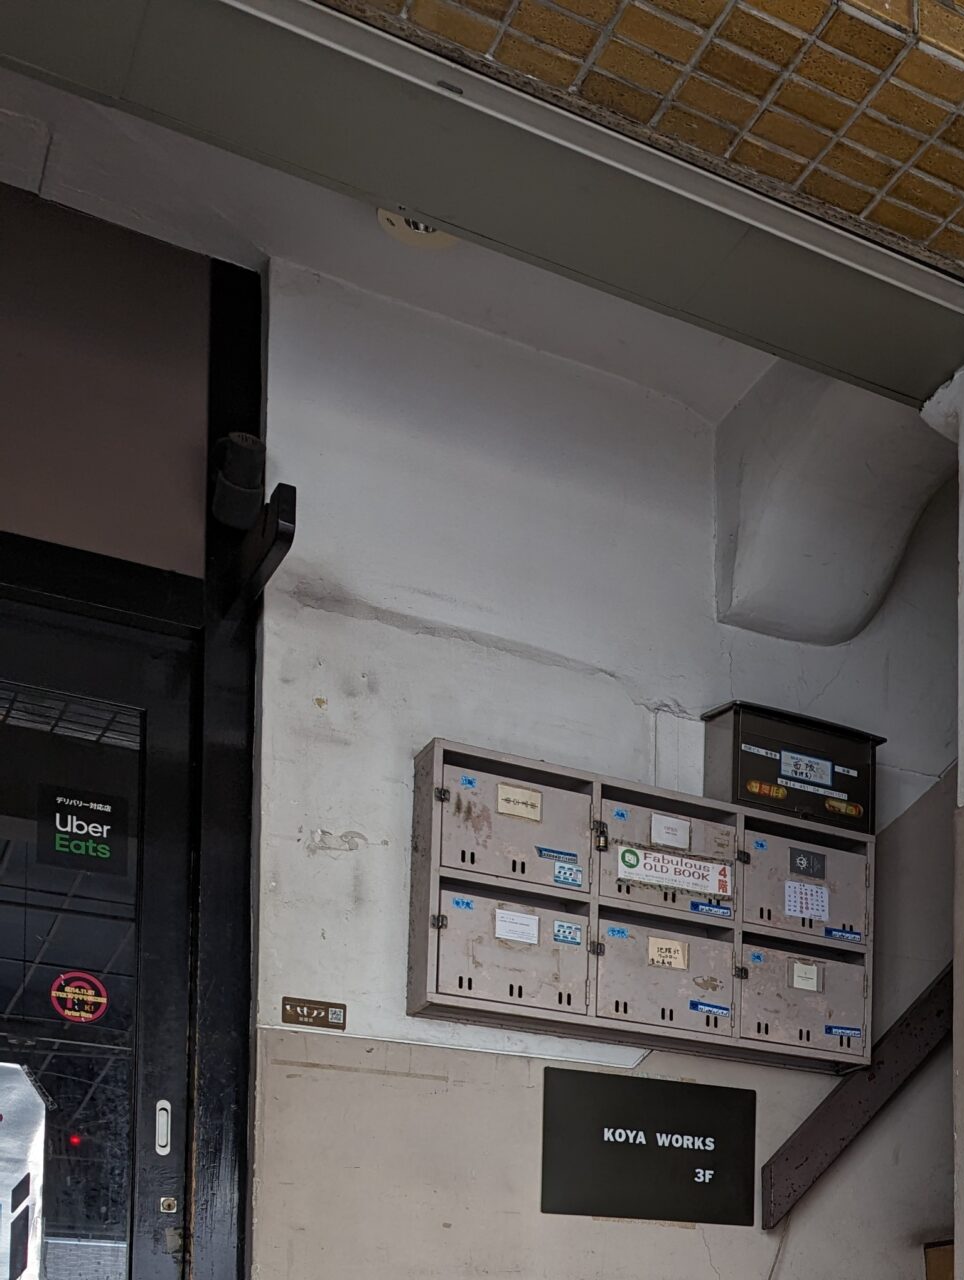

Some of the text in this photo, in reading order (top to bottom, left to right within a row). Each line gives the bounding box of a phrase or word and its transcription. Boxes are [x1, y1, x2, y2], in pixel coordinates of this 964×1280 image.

[56, 796, 112, 813] デリバリー対応店
[56, 813, 111, 838] Uber
[55, 833, 111, 858] Eats
[643, 852, 711, 873] Fabulous
[643, 862, 669, 874] OLD
[673, 867, 710, 882] BOOK
[603, 1127, 716, 1151] KOYA WORKS
[694, 1168, 715, 1183] 3F
